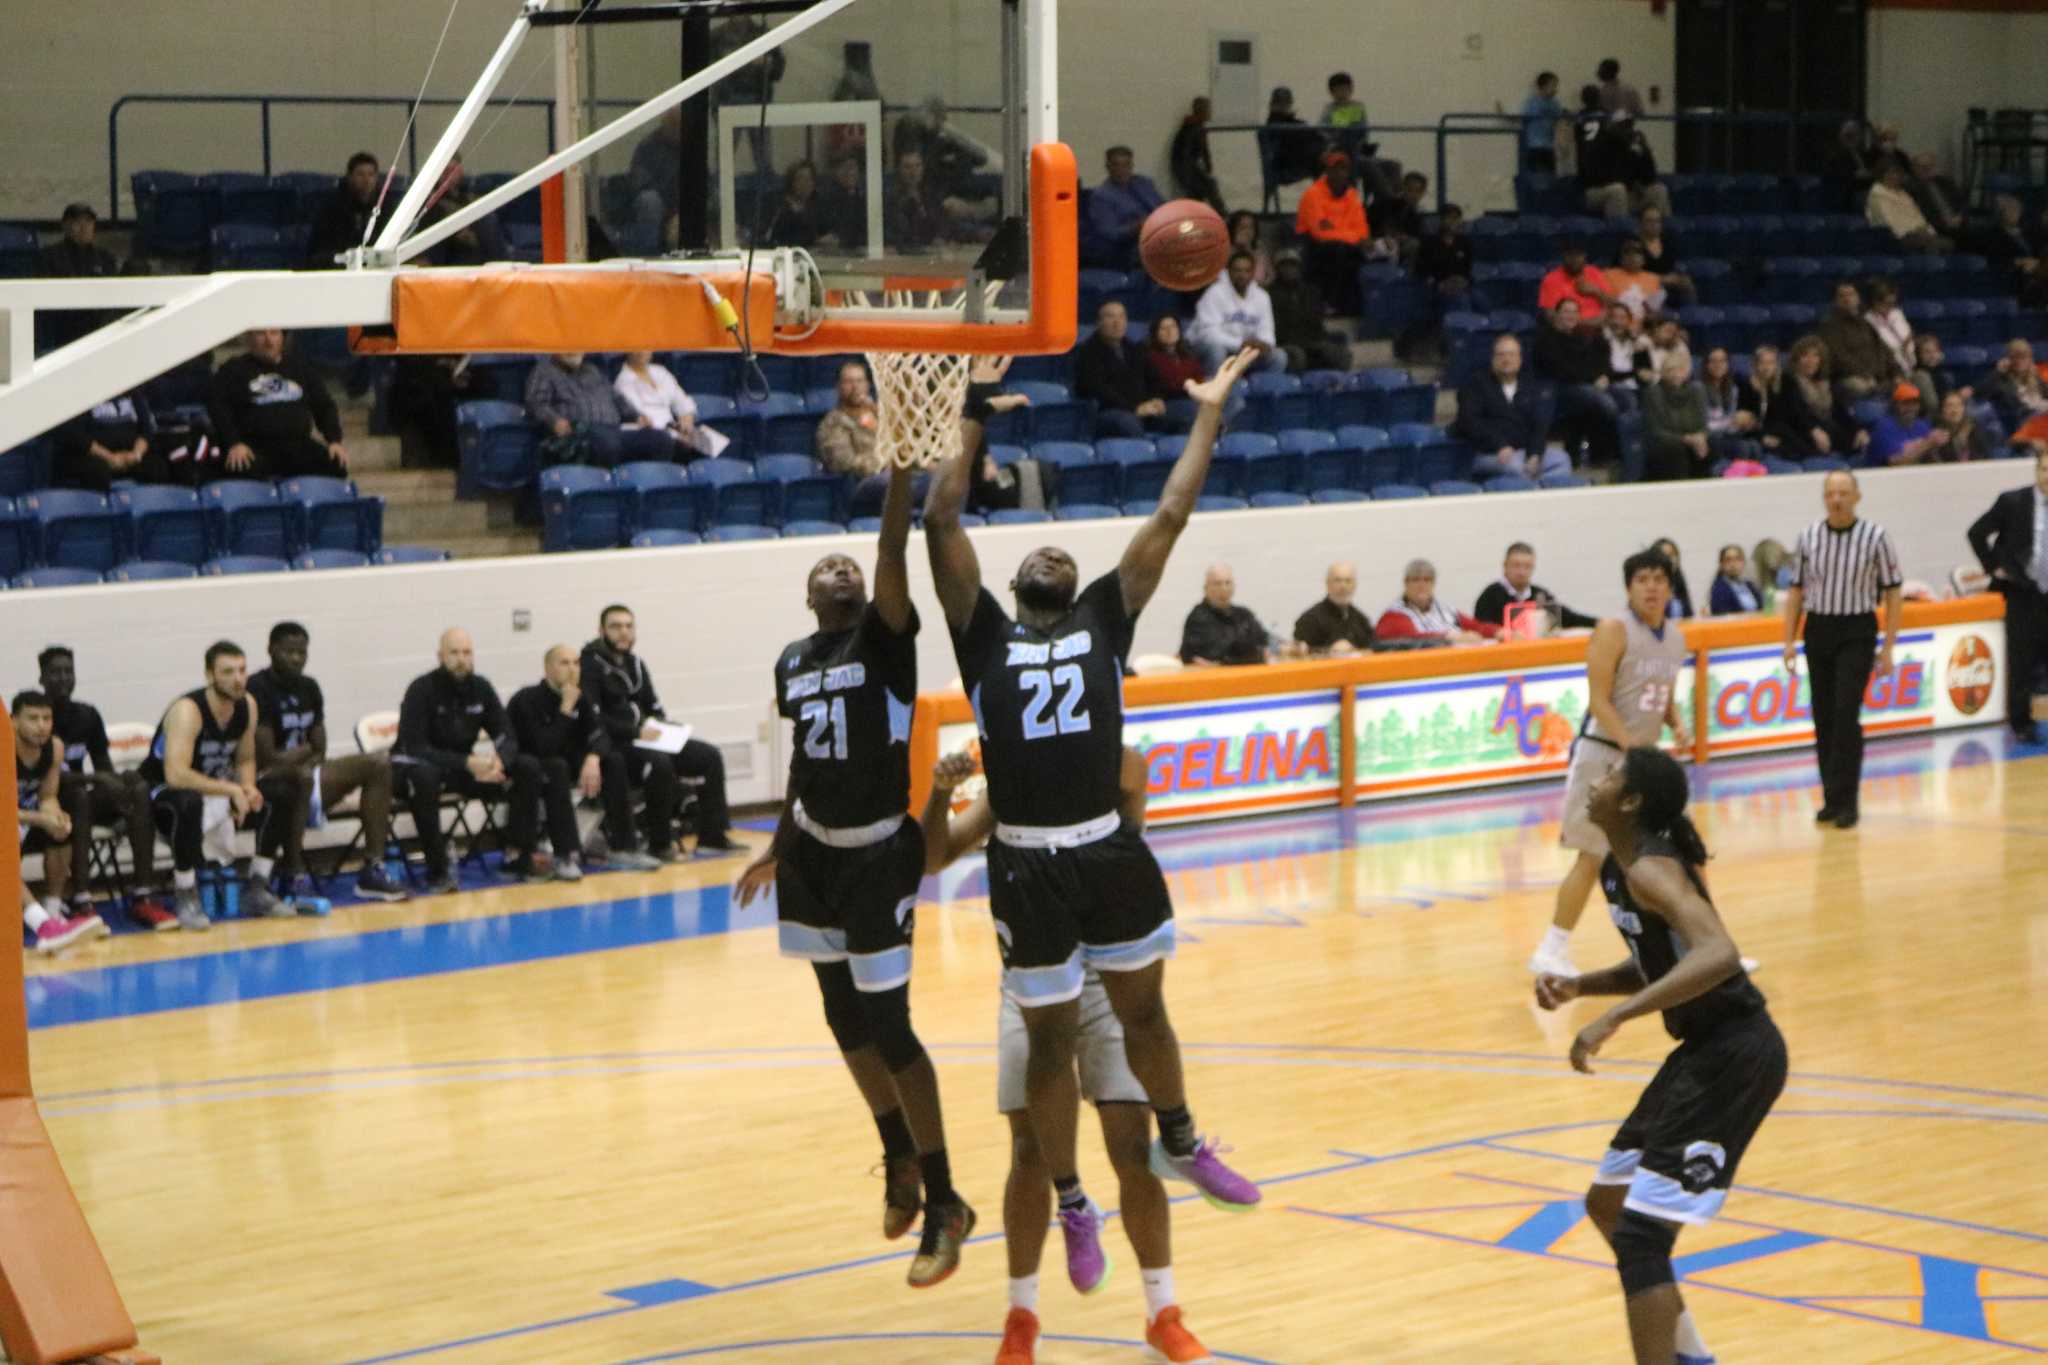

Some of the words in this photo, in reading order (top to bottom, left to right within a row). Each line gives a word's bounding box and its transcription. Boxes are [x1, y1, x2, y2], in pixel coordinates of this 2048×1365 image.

[801, 696, 848, 760] 21
[1019, 662, 1092, 741] 22
[1715, 661, 1923, 728] COLGE
[1144, 729, 1332, 796] GELINA
